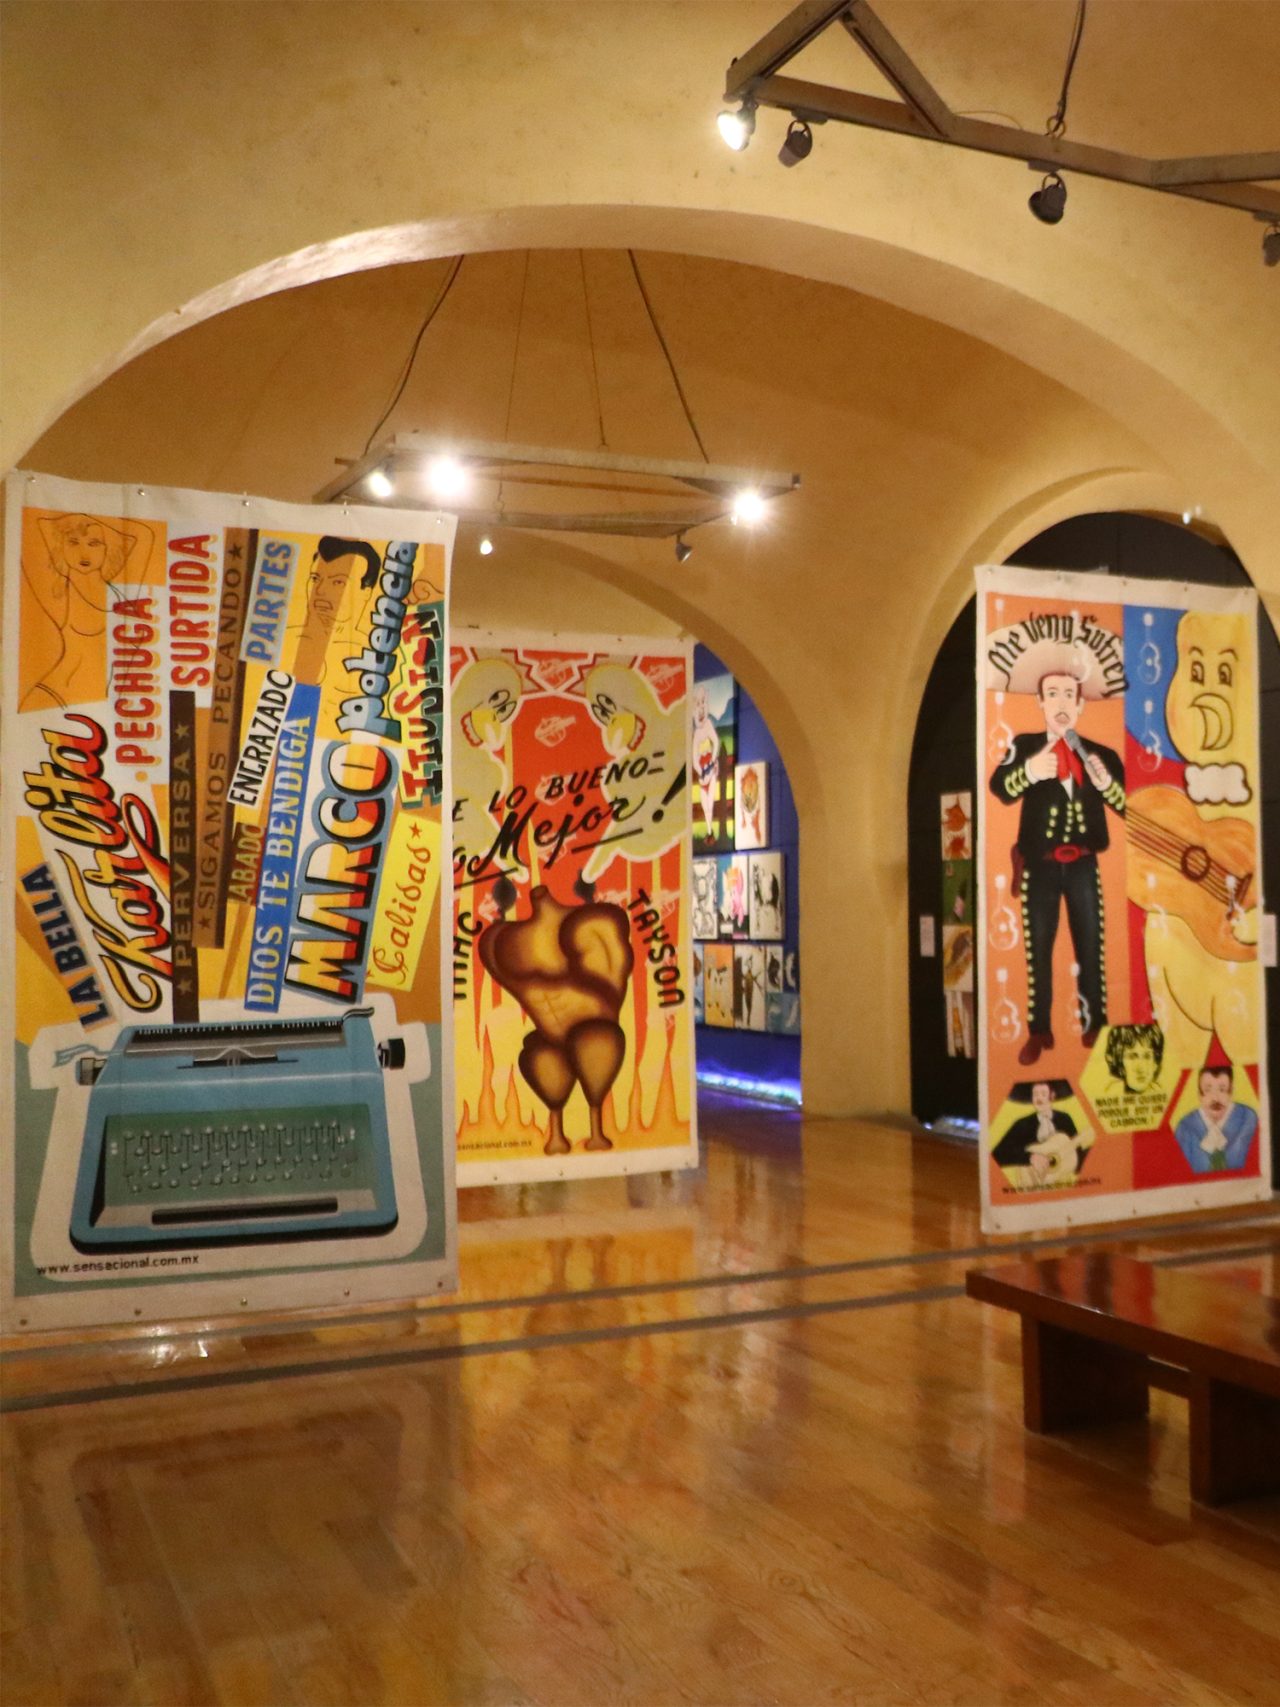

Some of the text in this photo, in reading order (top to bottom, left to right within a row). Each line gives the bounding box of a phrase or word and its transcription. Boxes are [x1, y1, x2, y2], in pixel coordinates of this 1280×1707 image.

[112, 597, 161, 767] PECHUGA
[168, 533, 216, 688] SURTIDA
[246, 540, 293, 662] PARTES
[199, 568, 242, 911] SIGAMOS PECANDO
[452, 798, 470, 823] E
[488, 784, 528, 814] LO
[172, 747, 193, 969] PERVERSA
[248, 715, 312, 1005] DIOS TE BENDIGA
[284, 744, 393, 1002] MARCO
[20, 863, 113, 1027] LA BELLA
[627, 888, 686, 1008] TAYSON
[36, 1255, 199, 1276] www.sensacional.com.mx
